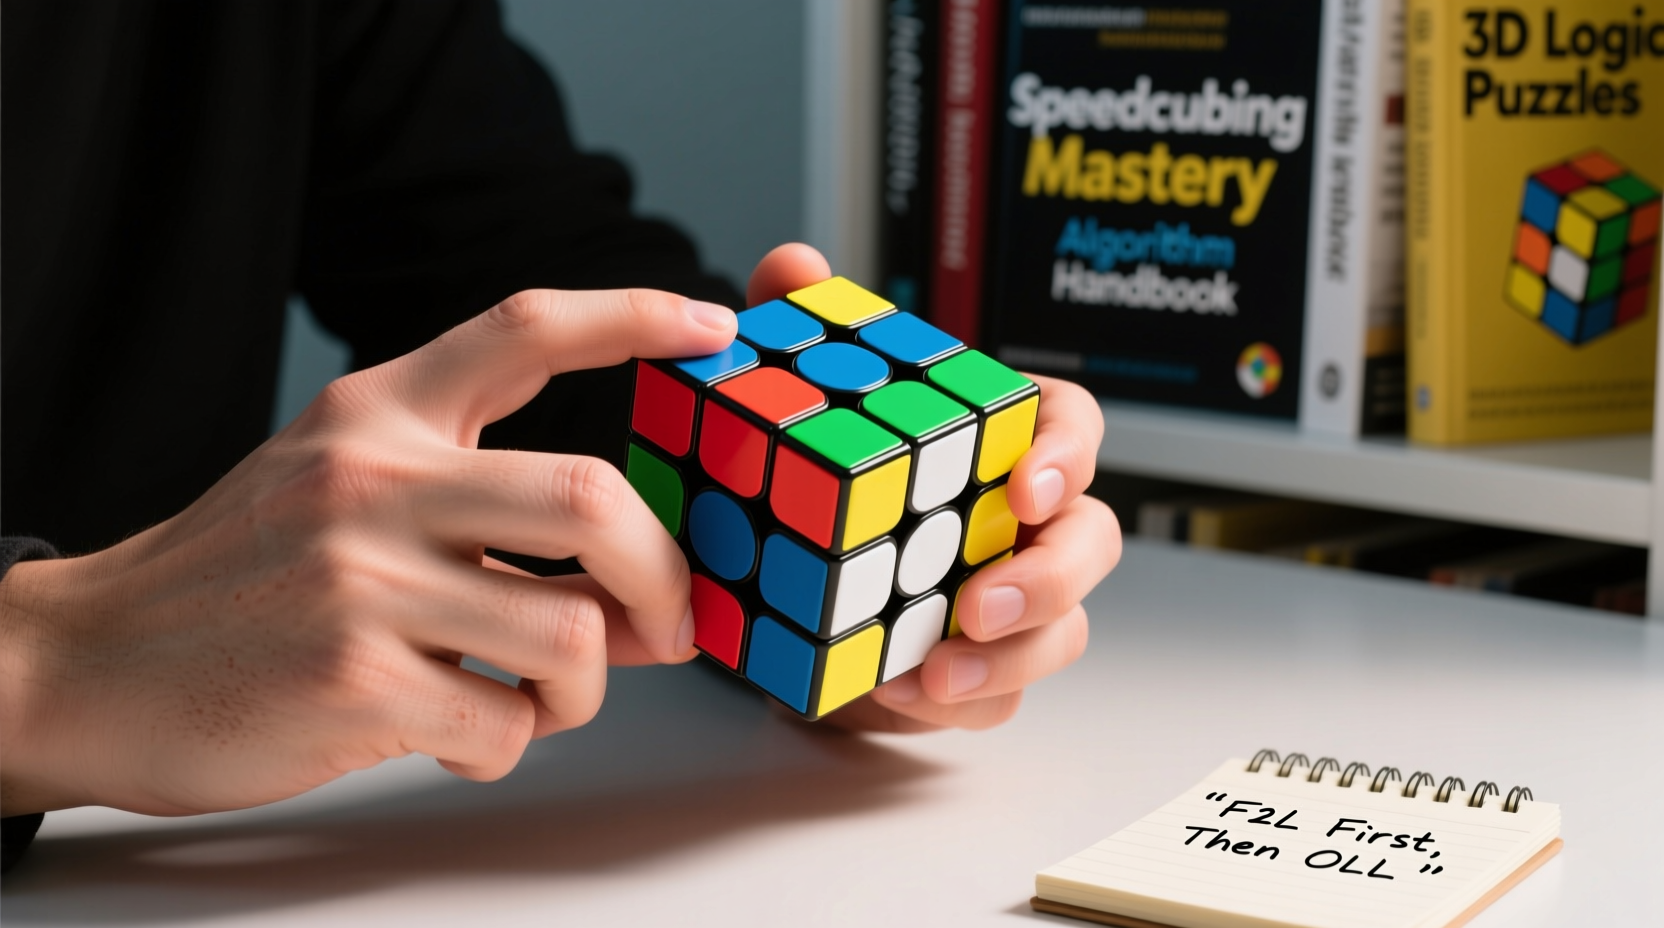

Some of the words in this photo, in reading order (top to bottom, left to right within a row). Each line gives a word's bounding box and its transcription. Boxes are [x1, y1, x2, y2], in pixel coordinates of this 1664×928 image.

[1463, 9, 1530, 59] 3D
[1008, 72, 1307, 152] Speedcubing
[1463, 66, 1643, 118] Puzzles
[1023, 134, 1277, 226] Mastery
[1057, 216, 1236, 272] Algorithm
[1052, 258, 1239, 315] Handbook
[1184, 825, 1280, 860] Then
[1326, 818, 1441, 859] First,
